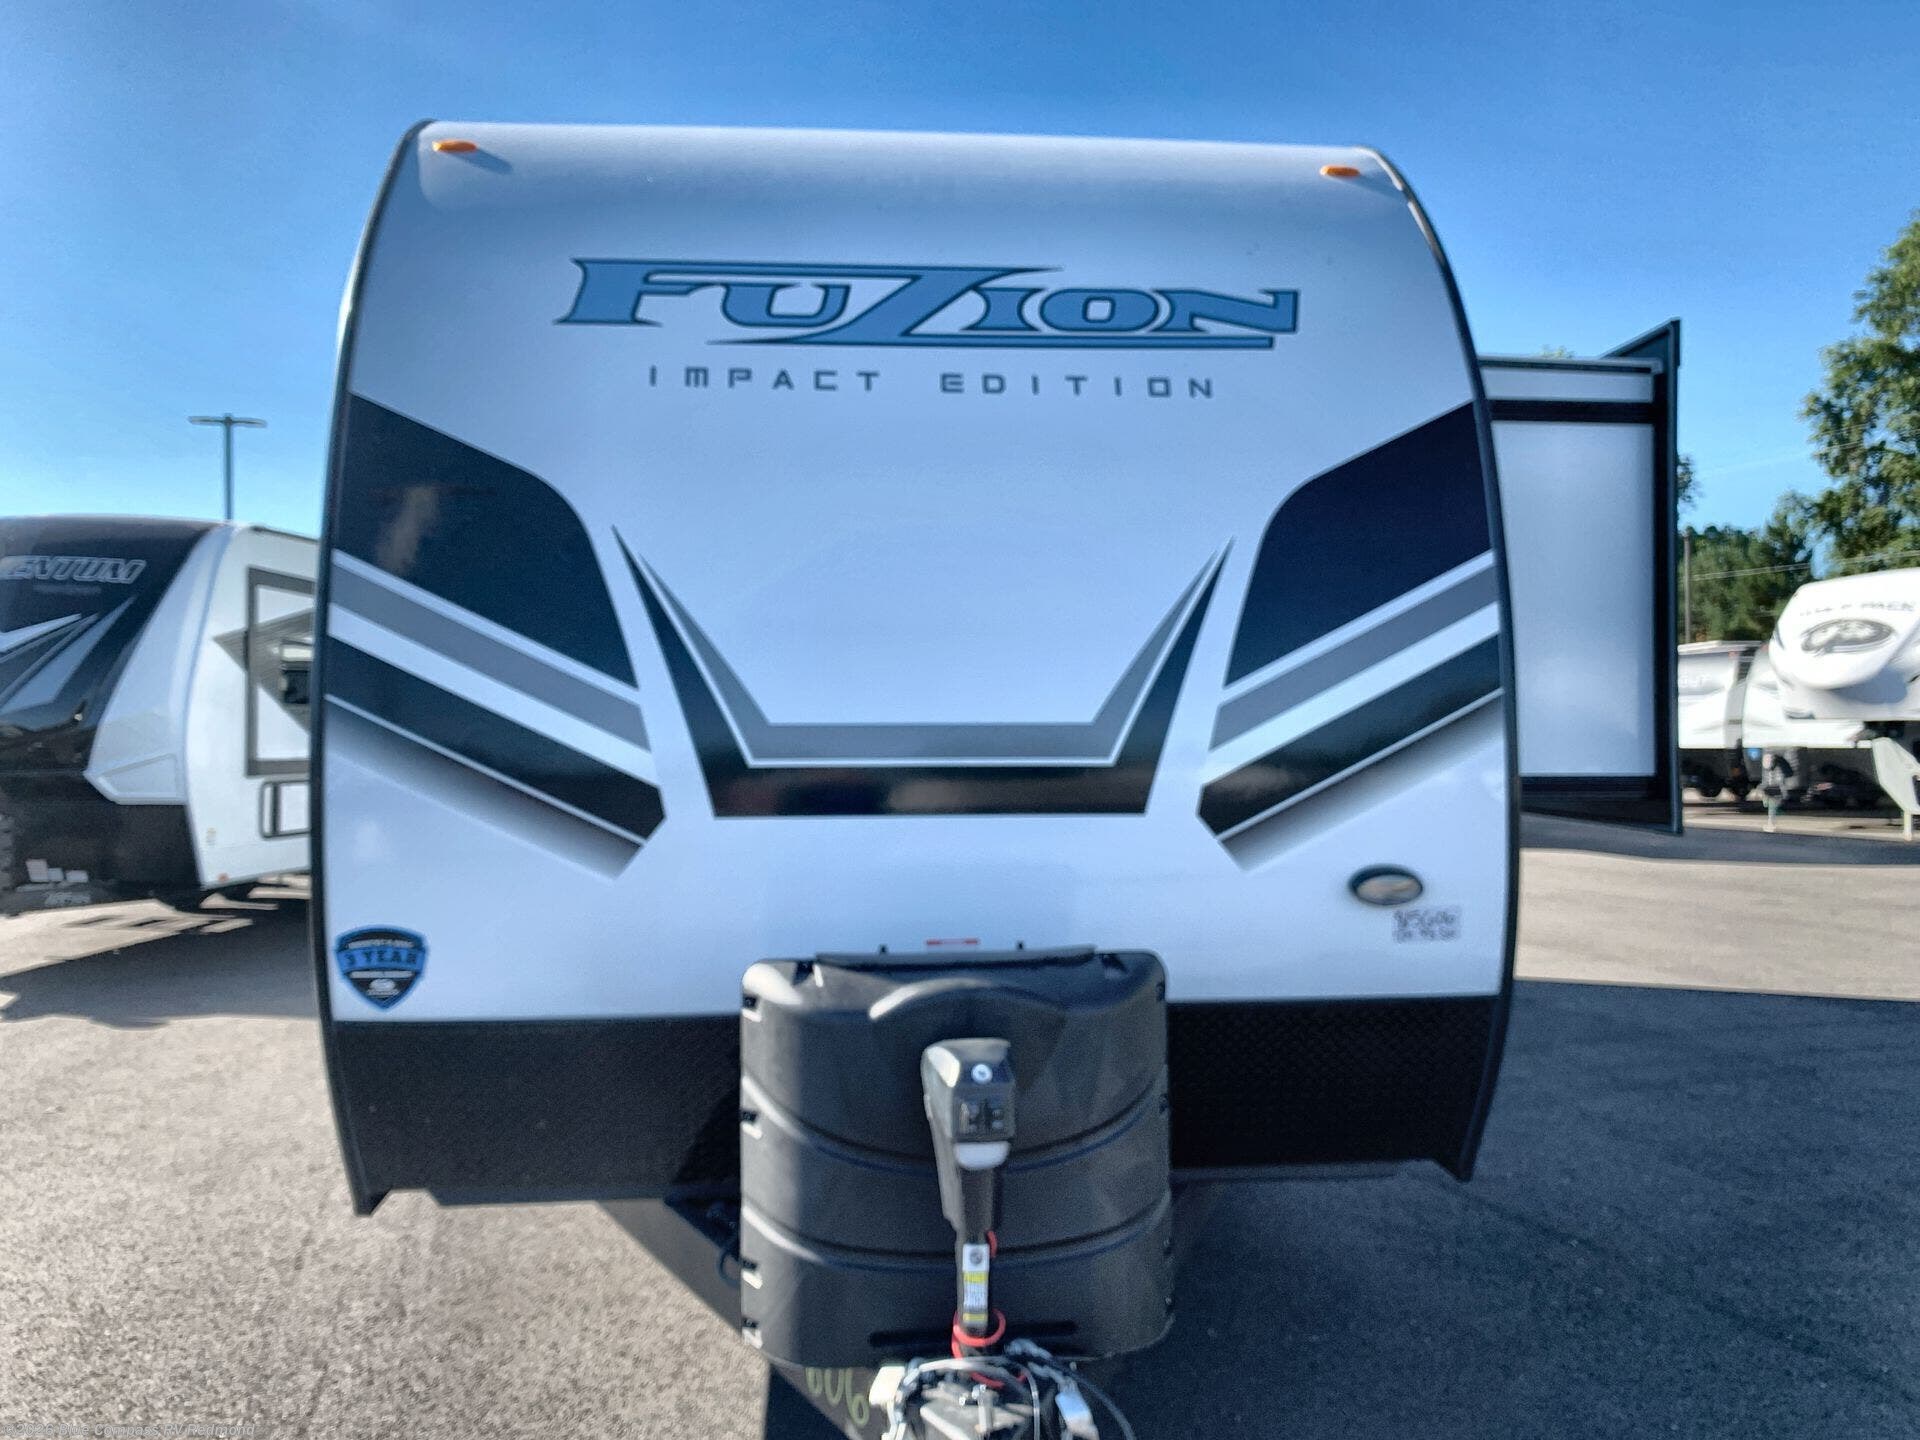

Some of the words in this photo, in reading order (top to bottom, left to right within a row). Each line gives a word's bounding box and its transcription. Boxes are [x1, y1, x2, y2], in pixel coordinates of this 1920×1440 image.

[552, 257, 1300, 350] FUZION
[648, 364, 880, 392] IMPACT
[938, 372, 1215, 399] EDITION
